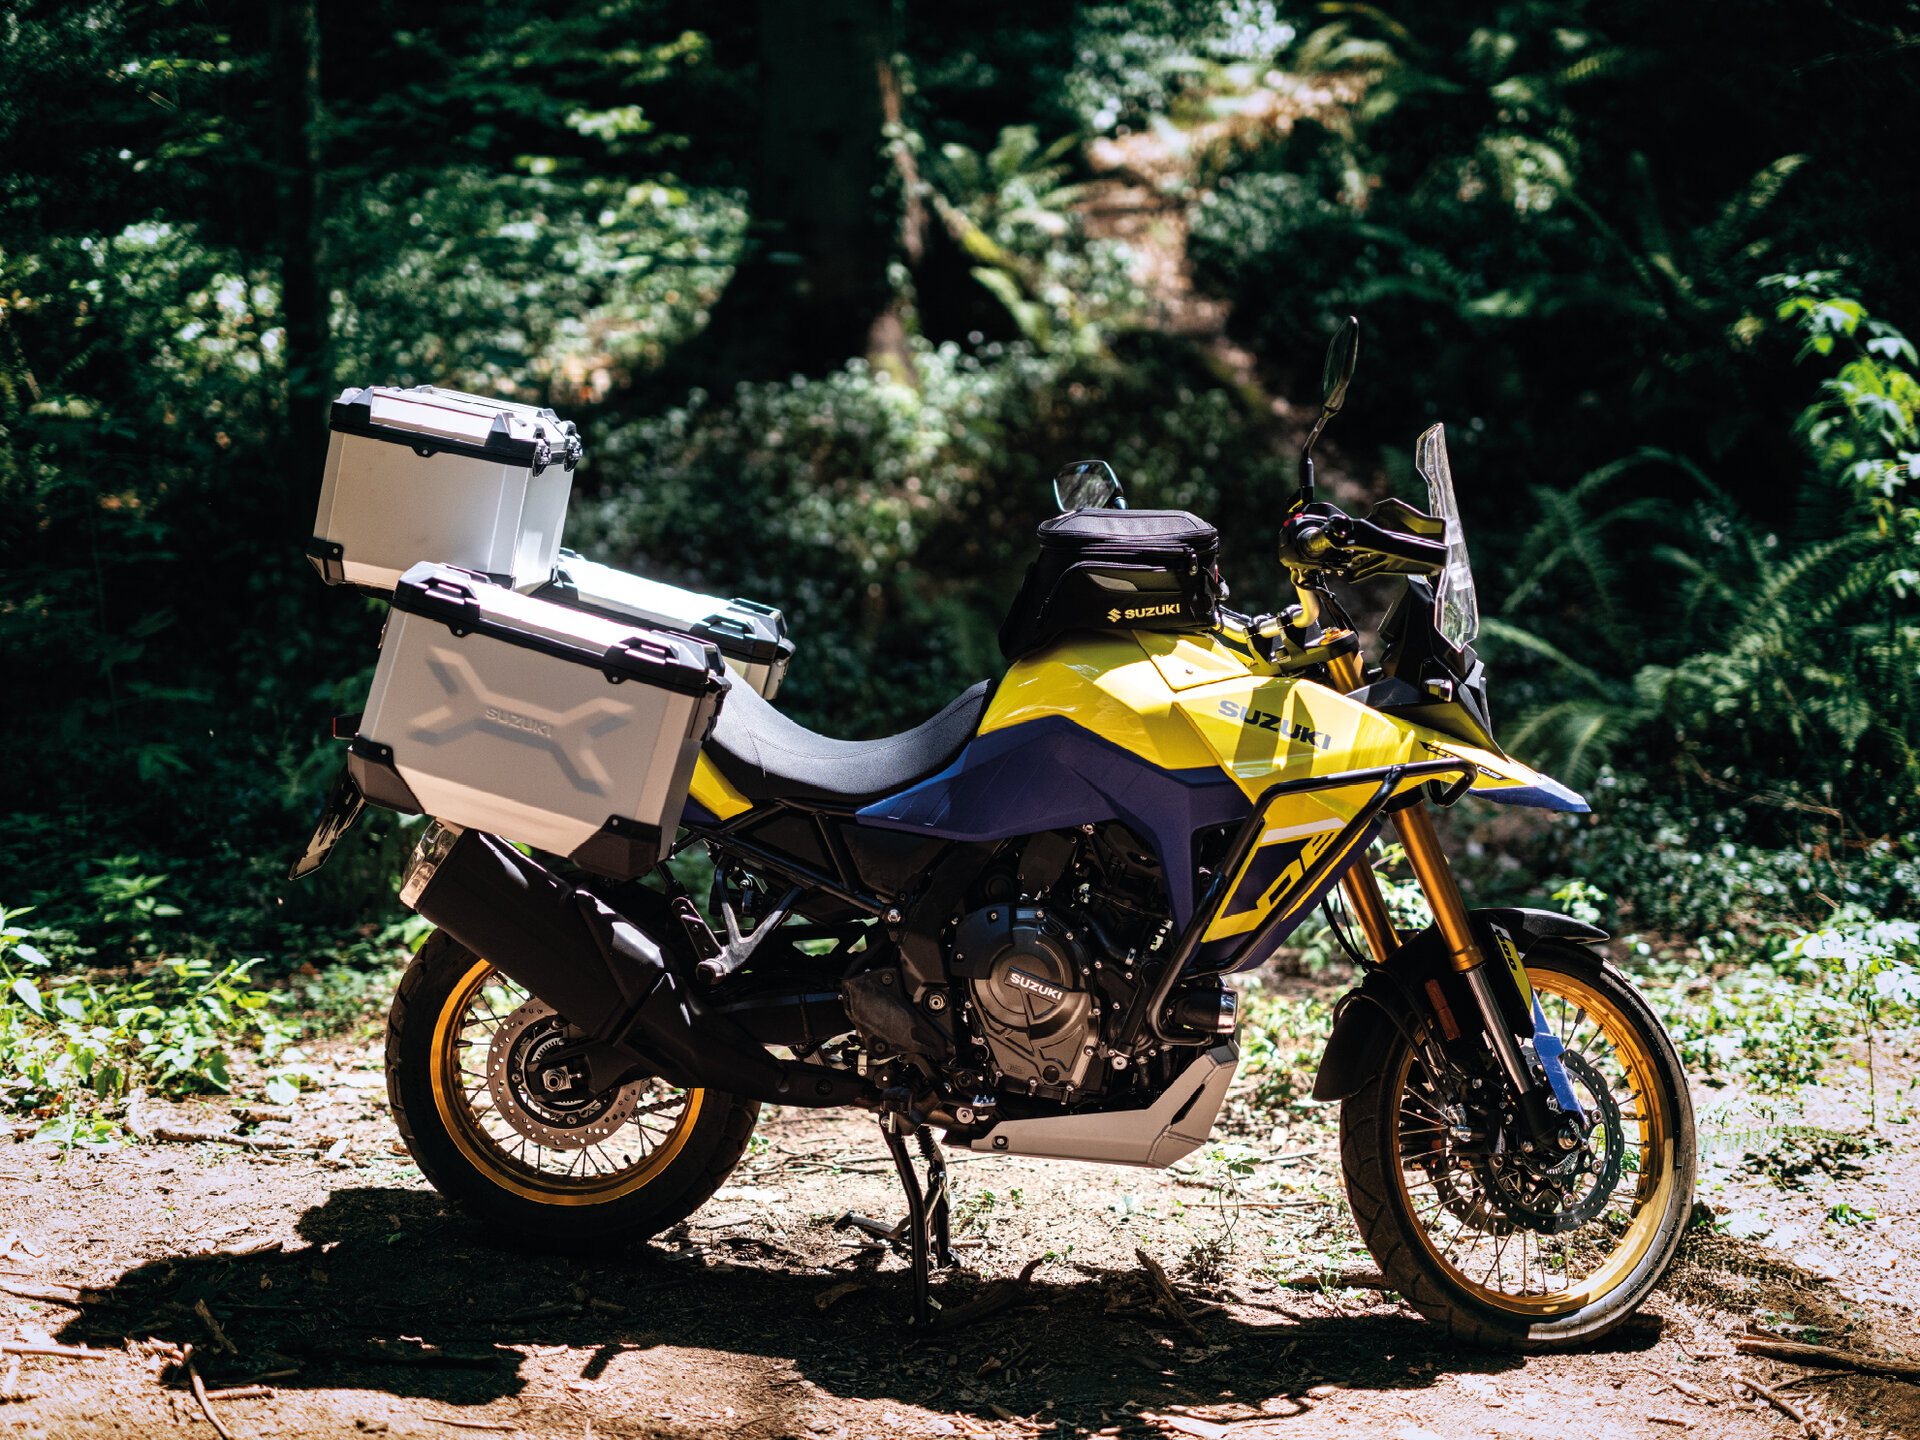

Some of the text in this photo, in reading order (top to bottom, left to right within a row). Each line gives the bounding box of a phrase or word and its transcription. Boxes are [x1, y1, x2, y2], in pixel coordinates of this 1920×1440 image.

[1124, 603, 1181, 620] SUZUKI
[485, 706, 552, 738] SUZUKI
[1218, 700, 1331, 750] SUZUKI
[1010, 973, 1063, 1000] SUZUKI
